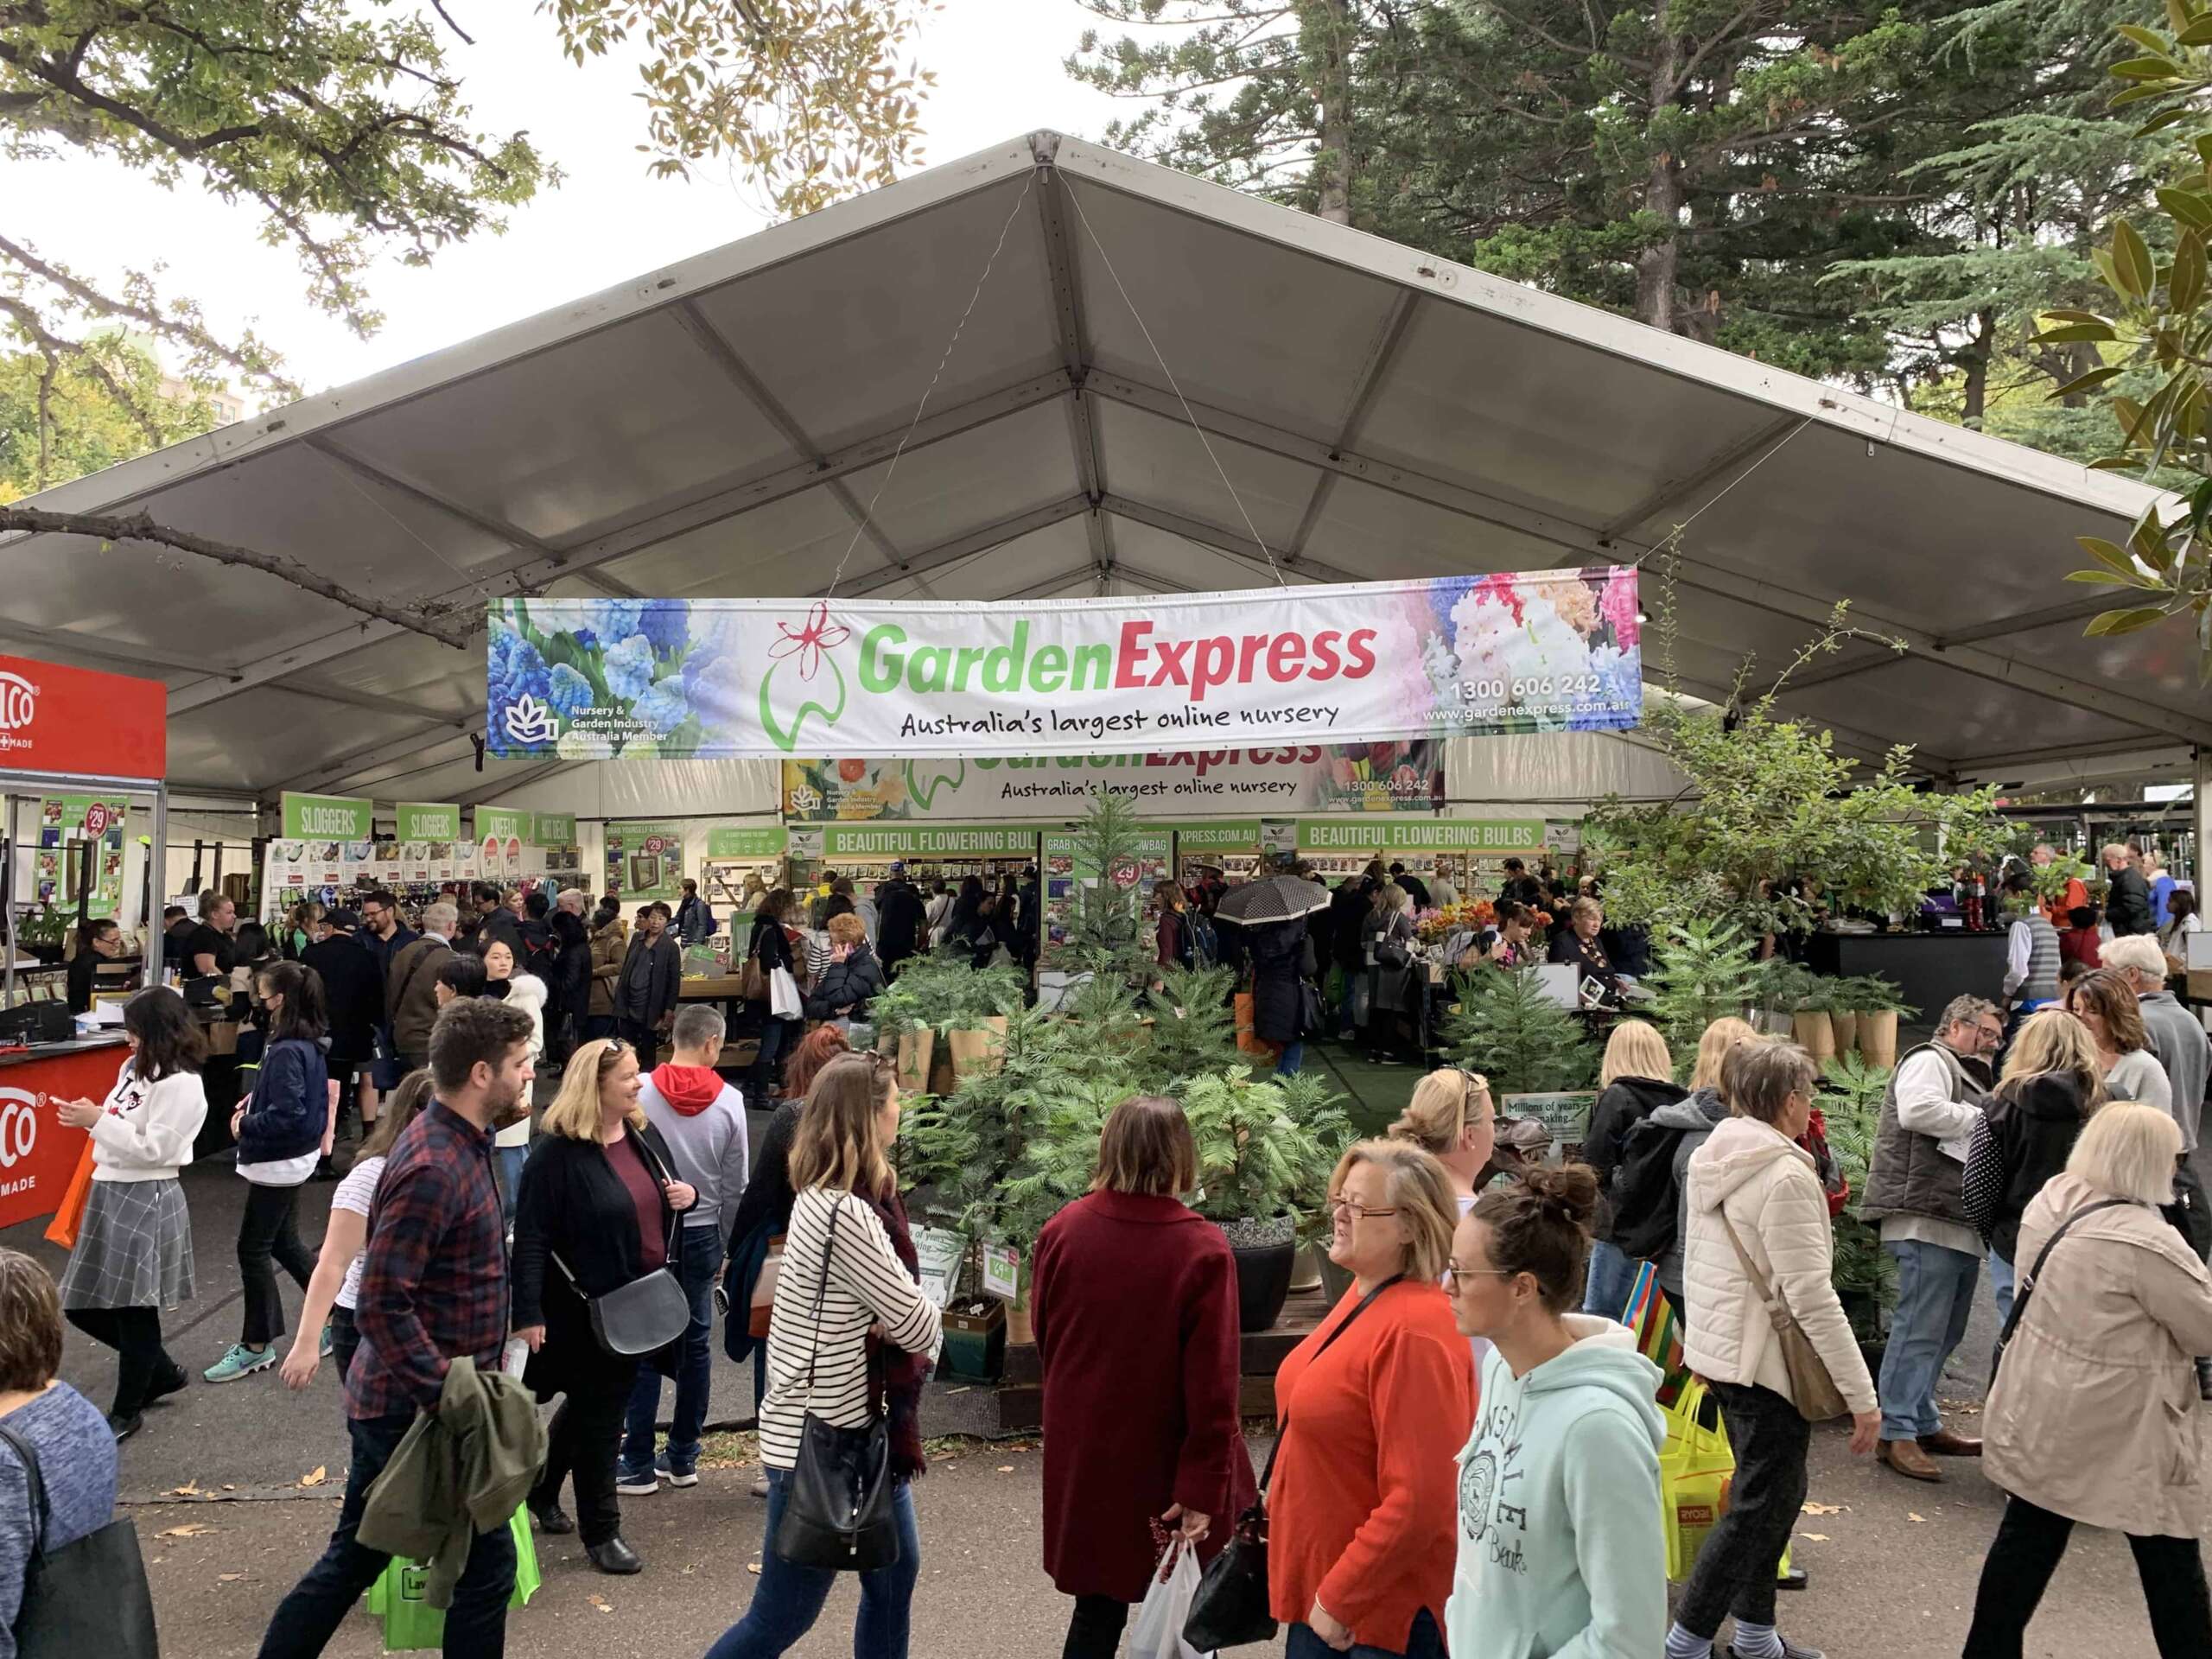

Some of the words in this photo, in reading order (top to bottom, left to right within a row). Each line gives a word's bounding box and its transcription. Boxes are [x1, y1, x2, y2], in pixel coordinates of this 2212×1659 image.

[858, 620, 1377, 701] GardenExpress
[1450, 679, 1503, 700] 1300
[1512, 677, 1553, 696] 606
[1561, 675, 1601, 693] 242
[571, 706, 614, 717] Nursery
[616, 705, 625, 715] &
[1423, 701, 1630, 721] www.gardenexpress.com.au
[571, 718, 611, 728] Garden
[613, 718, 658, 729] Industry
[901, 709, 1042, 736] Australia's
[1052, 709, 1148, 738] largest
[1158, 705, 1230, 728] online
[1241, 704, 1339, 727] nursery
[10, 739, 33, 749] MADE
[571, 731, 620, 741] Australia
[622, 731, 668, 741] Member
[1001, 780, 1096, 798] Australia's
[1103, 779, 1167, 799] largest
[1174, 779, 1224, 794] online
[1230, 780, 1297, 796] nursery
[1345, 780, 1375, 791] 1300
[1378, 779, 1402, 791] 606
[1405, 779, 1429, 791] 242
[1328, 793, 1443, 804] www.gardenexpress.com.au
[89, 810, 104, 829] $29
[302, 805, 356, 836] SLOGGERS
[411, 814, 450, 837] SLOGGERS
[836, 832, 916, 851] BEAUTIFUL
[920, 831, 1003, 851] FLOWERING
[1008, 831, 1036, 850] BUL
[1047, 838, 1071, 851] GRAB
[1179, 829, 1255, 843] XPRESS.COM.AU
[1310, 826, 1389, 845] BEAUTIFUL
[1394, 826, 1479, 846] FLOWERING
[1484, 826, 1533, 846] BULBS
[1508, 1102, 1543, 1113] Millions
[1546, 1101, 1555, 1111] of
[0, 1176, 35, 1197] MADE
[1681, 1509, 1709, 1520] RYOBI
